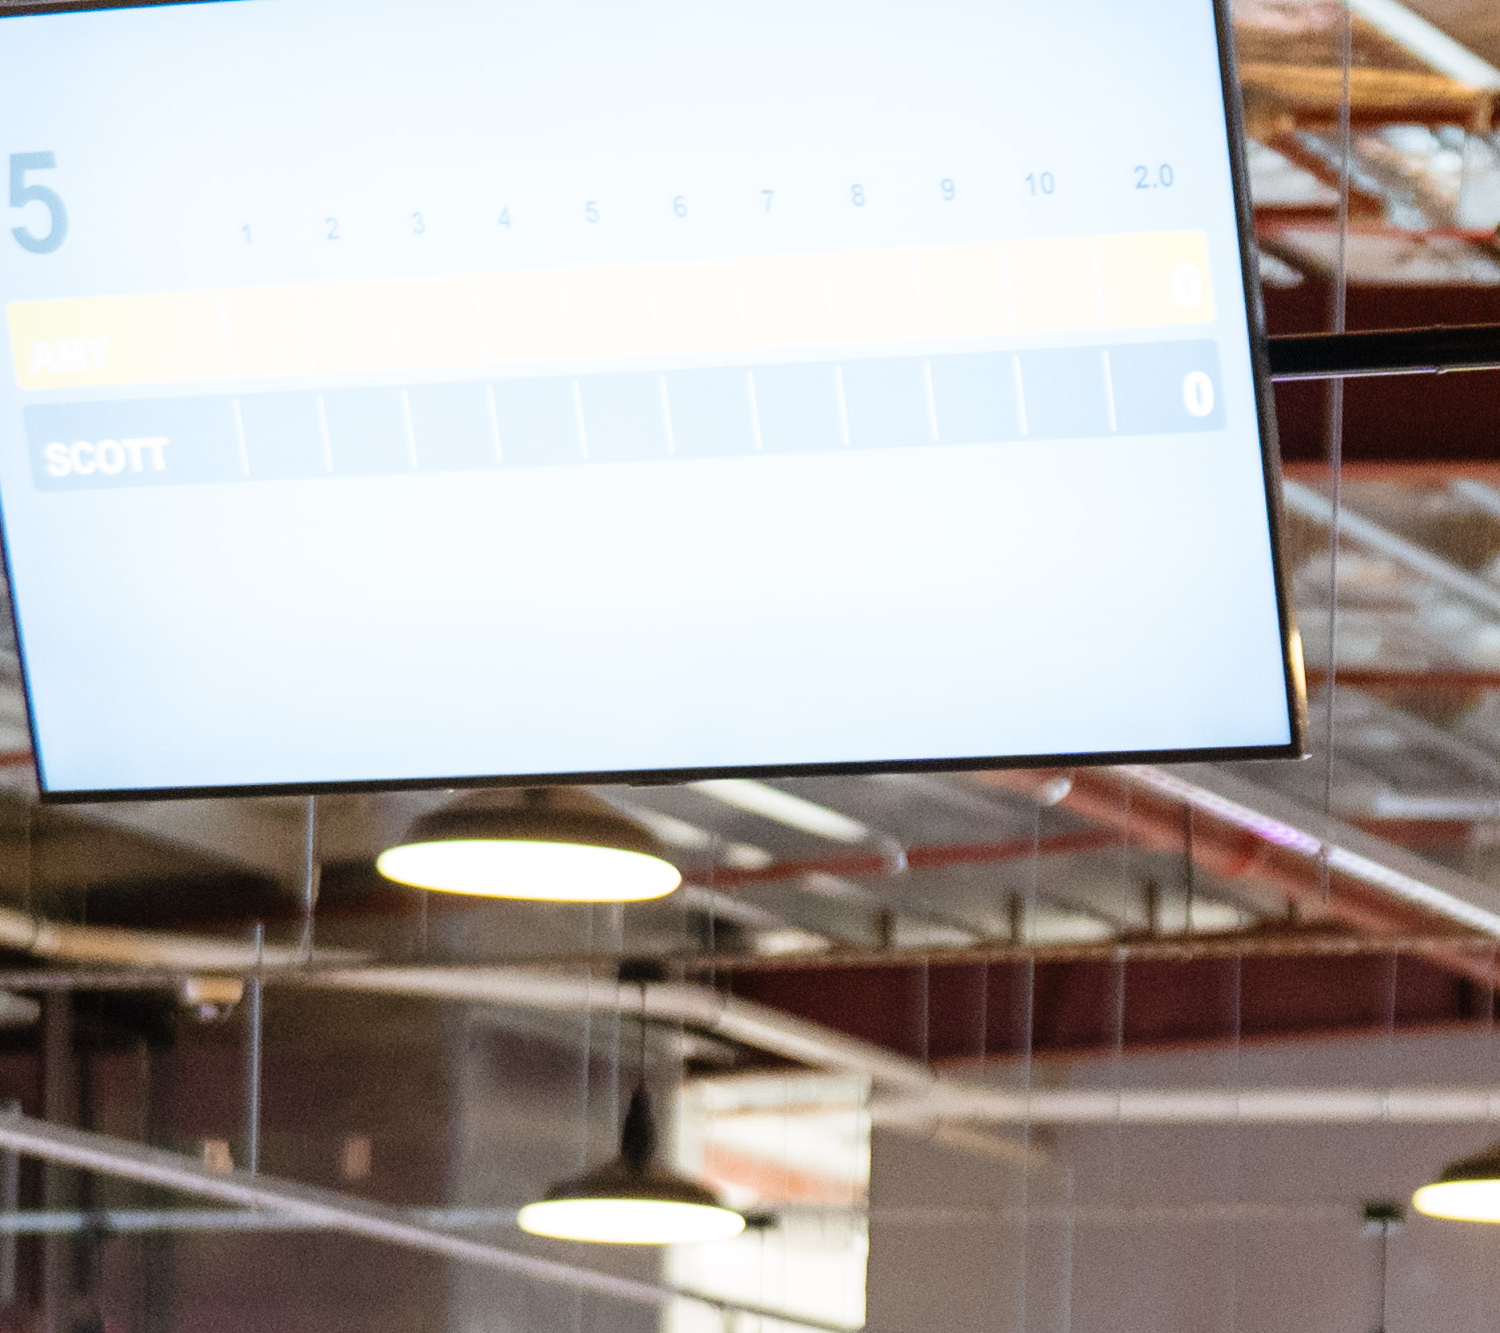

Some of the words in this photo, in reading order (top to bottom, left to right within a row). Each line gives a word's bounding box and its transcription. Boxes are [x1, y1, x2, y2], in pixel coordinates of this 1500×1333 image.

[8, 150, 69, 256] 5
[238, 221, 253, 247] 1
[322, 215, 342, 243] 2
[409, 210, 428, 237] 3
[495, 204, 515, 231] 4
[582, 198, 602, 226] 5
[669, 192, 690, 220] 6
[757, 187, 778, 214] 7
[847, 181, 869, 209] 8
[936, 175, 959, 204] 9
[1022, 169, 1058, 198] 10
[1131, 161, 1177, 193] 2.0
[44, 436, 170, 478] SCOTT
[1181, 370, 1215, 418] 0
